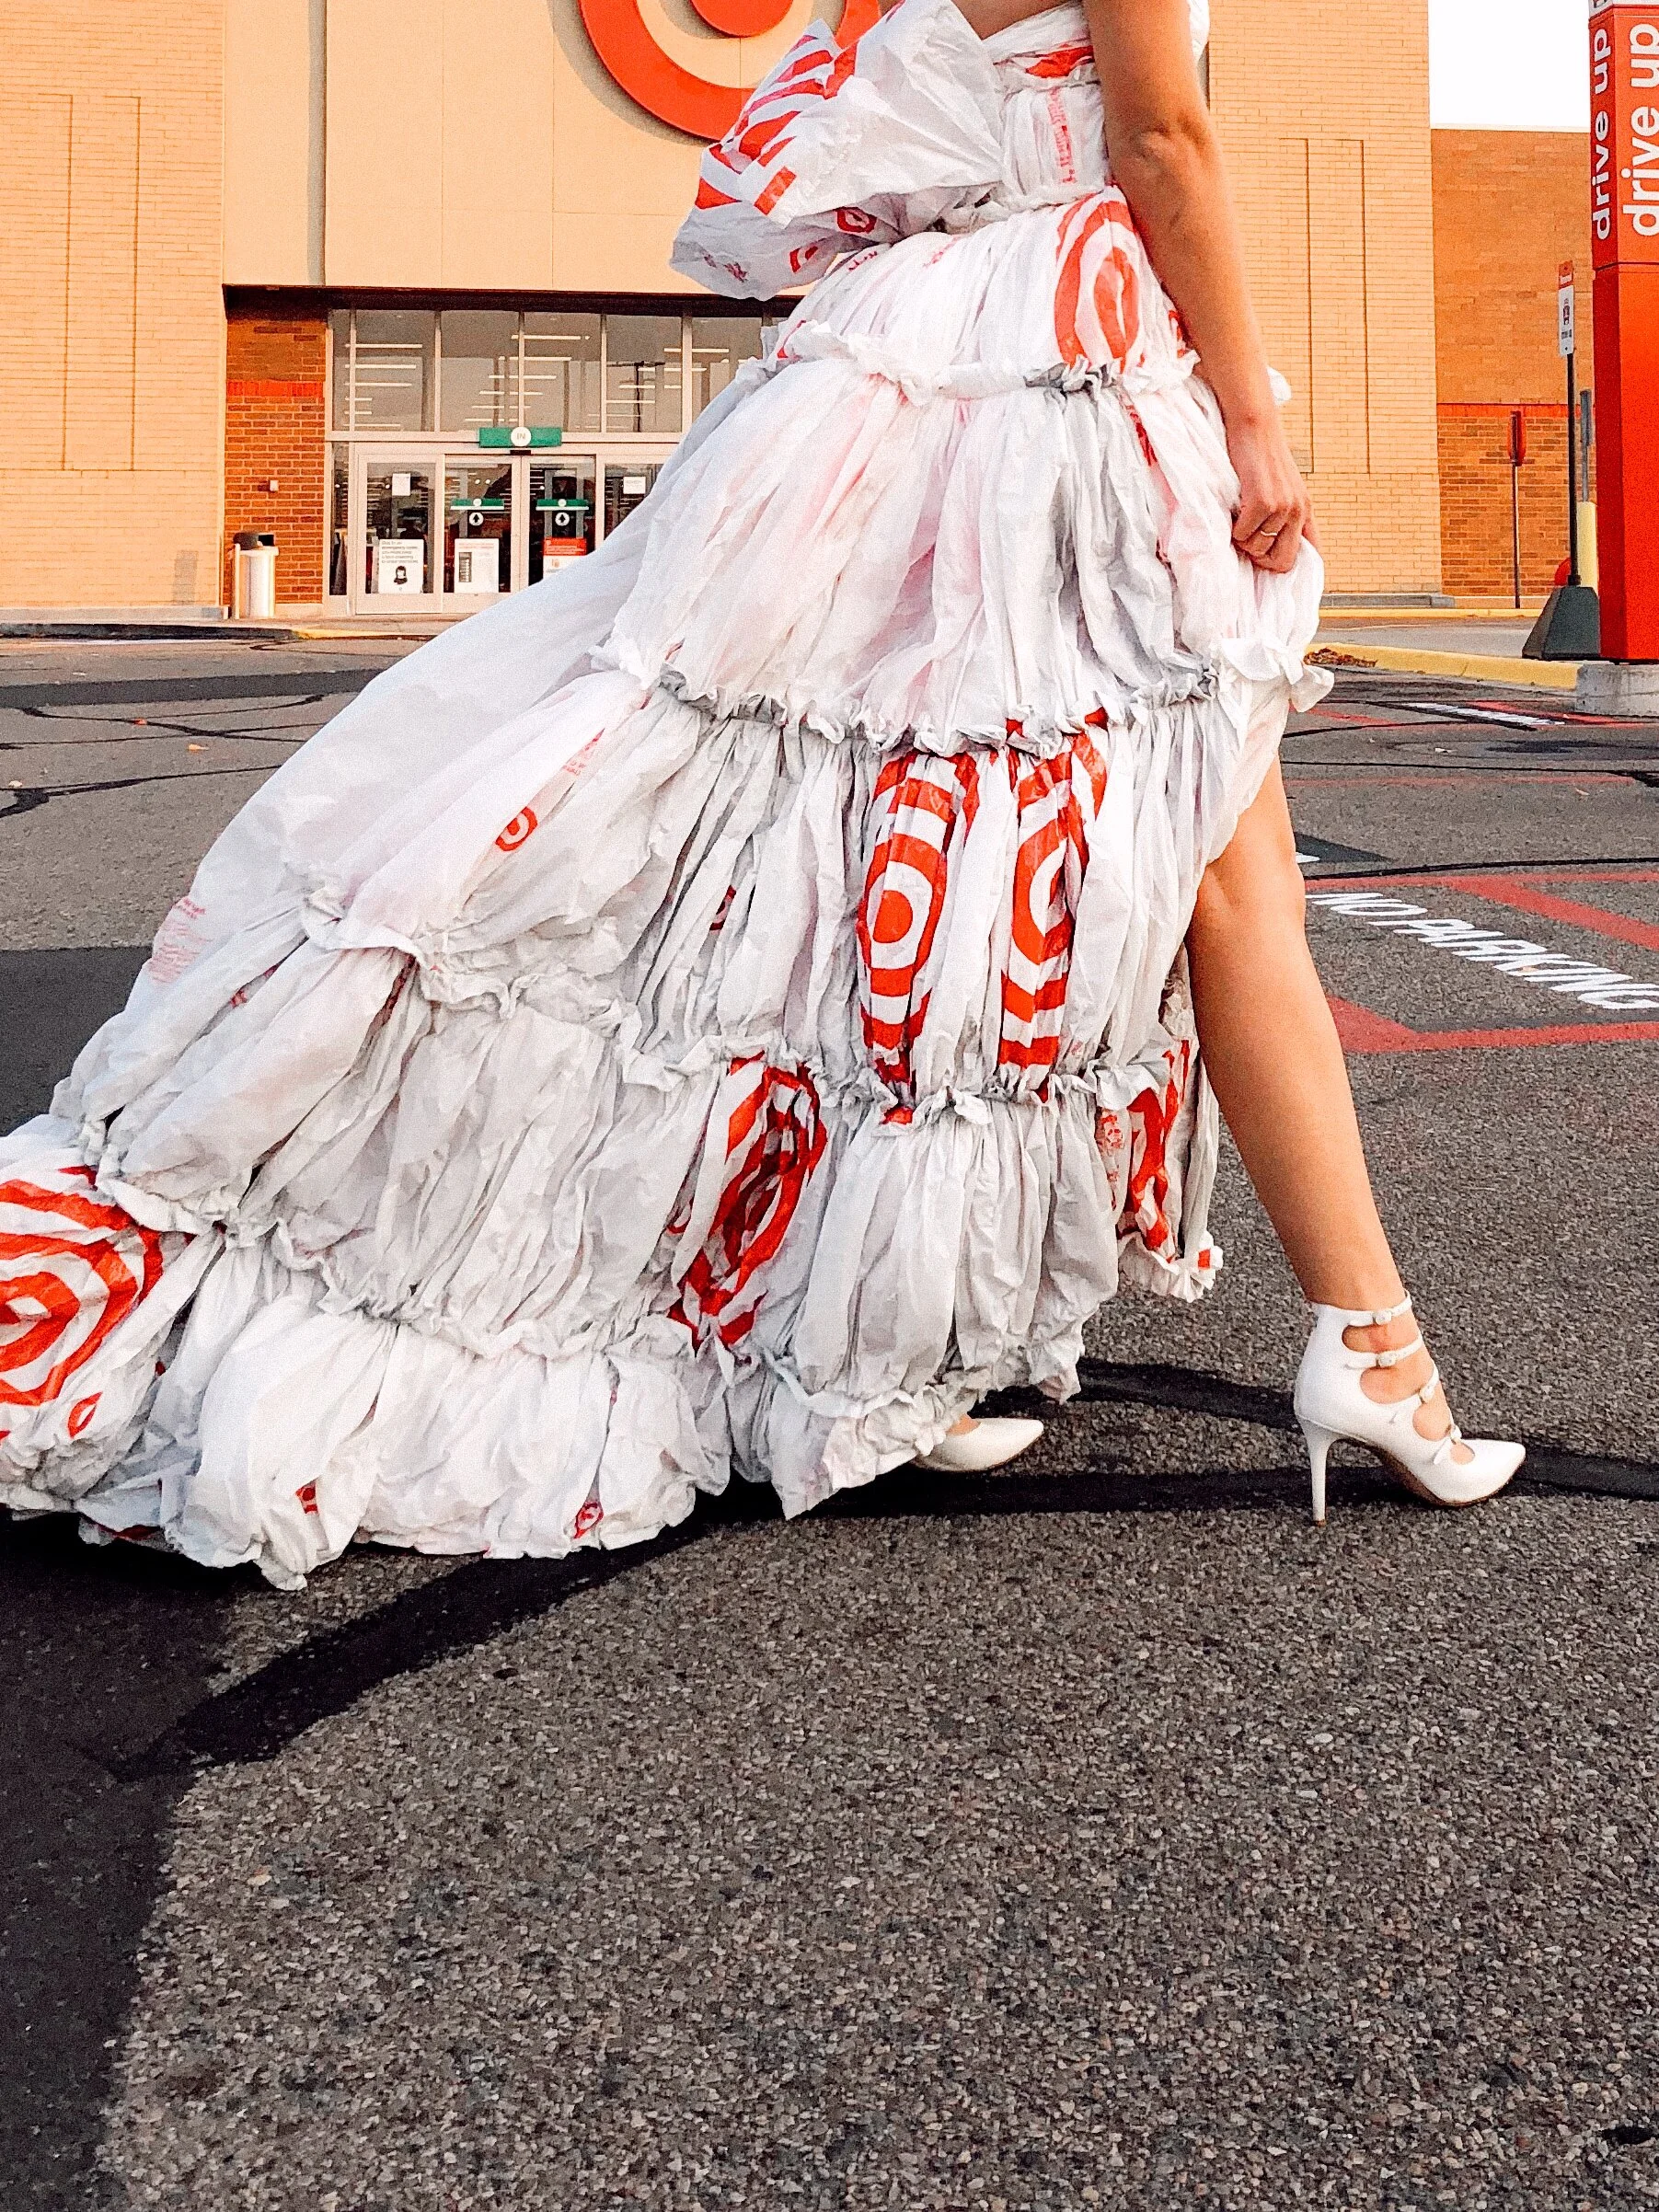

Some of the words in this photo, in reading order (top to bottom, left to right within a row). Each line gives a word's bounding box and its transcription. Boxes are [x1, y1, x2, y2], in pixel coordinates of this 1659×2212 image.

[1594, 29, 1611, 95] up
[1629, 23, 1659, 88] up
[1592, 110, 1610, 240] drive
[1621, 106, 1659, 236] drive
[1305, 893, 1428, 916] NO
[1365, 919, 1659, 1009] PARKING
